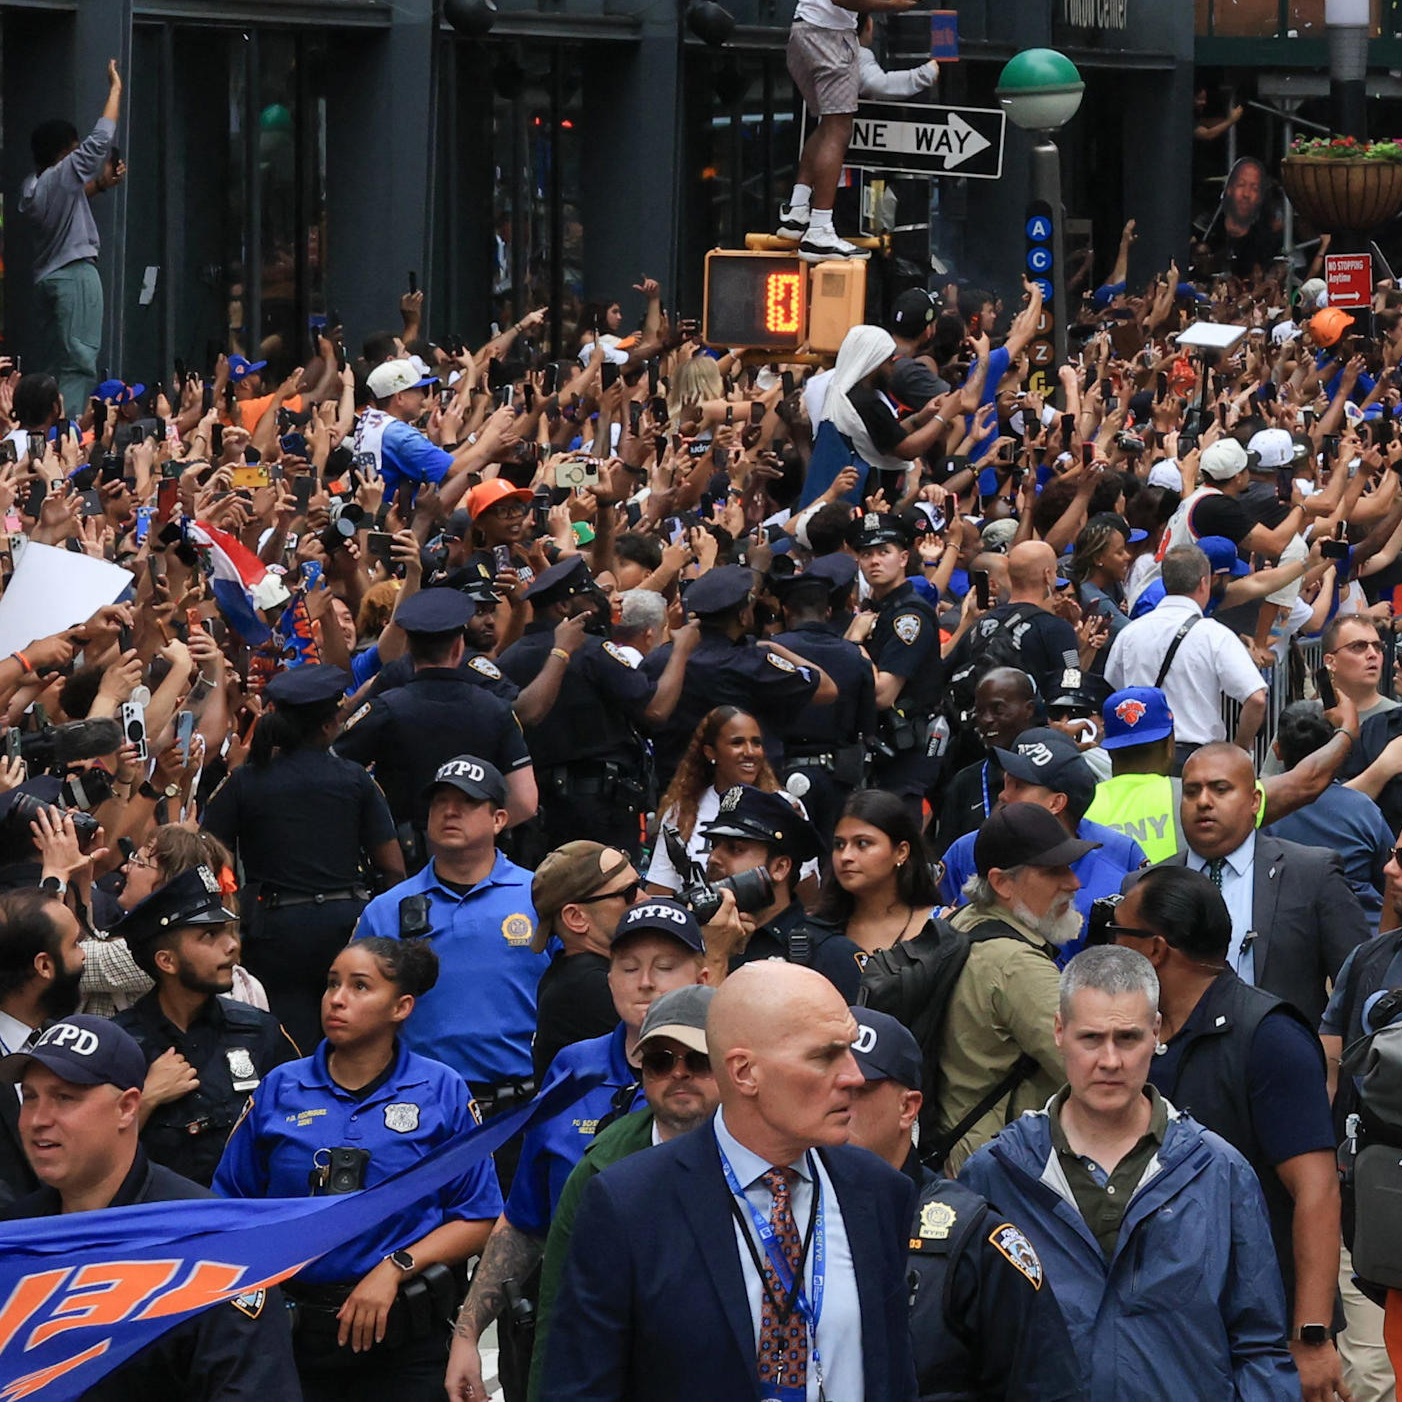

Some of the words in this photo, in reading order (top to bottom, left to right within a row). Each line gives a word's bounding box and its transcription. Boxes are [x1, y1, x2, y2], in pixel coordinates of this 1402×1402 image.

[852, 121, 888, 148] NE
[915, 127, 972, 154] WAY
[1032, 221, 1046, 236] A
[1032, 252, 1046, 268] C
[1328, 261, 1336, 271] NO
[1337, 260, 1364, 271] STOPPING
[1037, 315, 1046, 330] J
[1035, 347, 1047, 361] Z
[435, 760, 485, 782] NYPD
[627, 905, 687, 925] NYPD
[815, 1230, 825, 1262] serve
